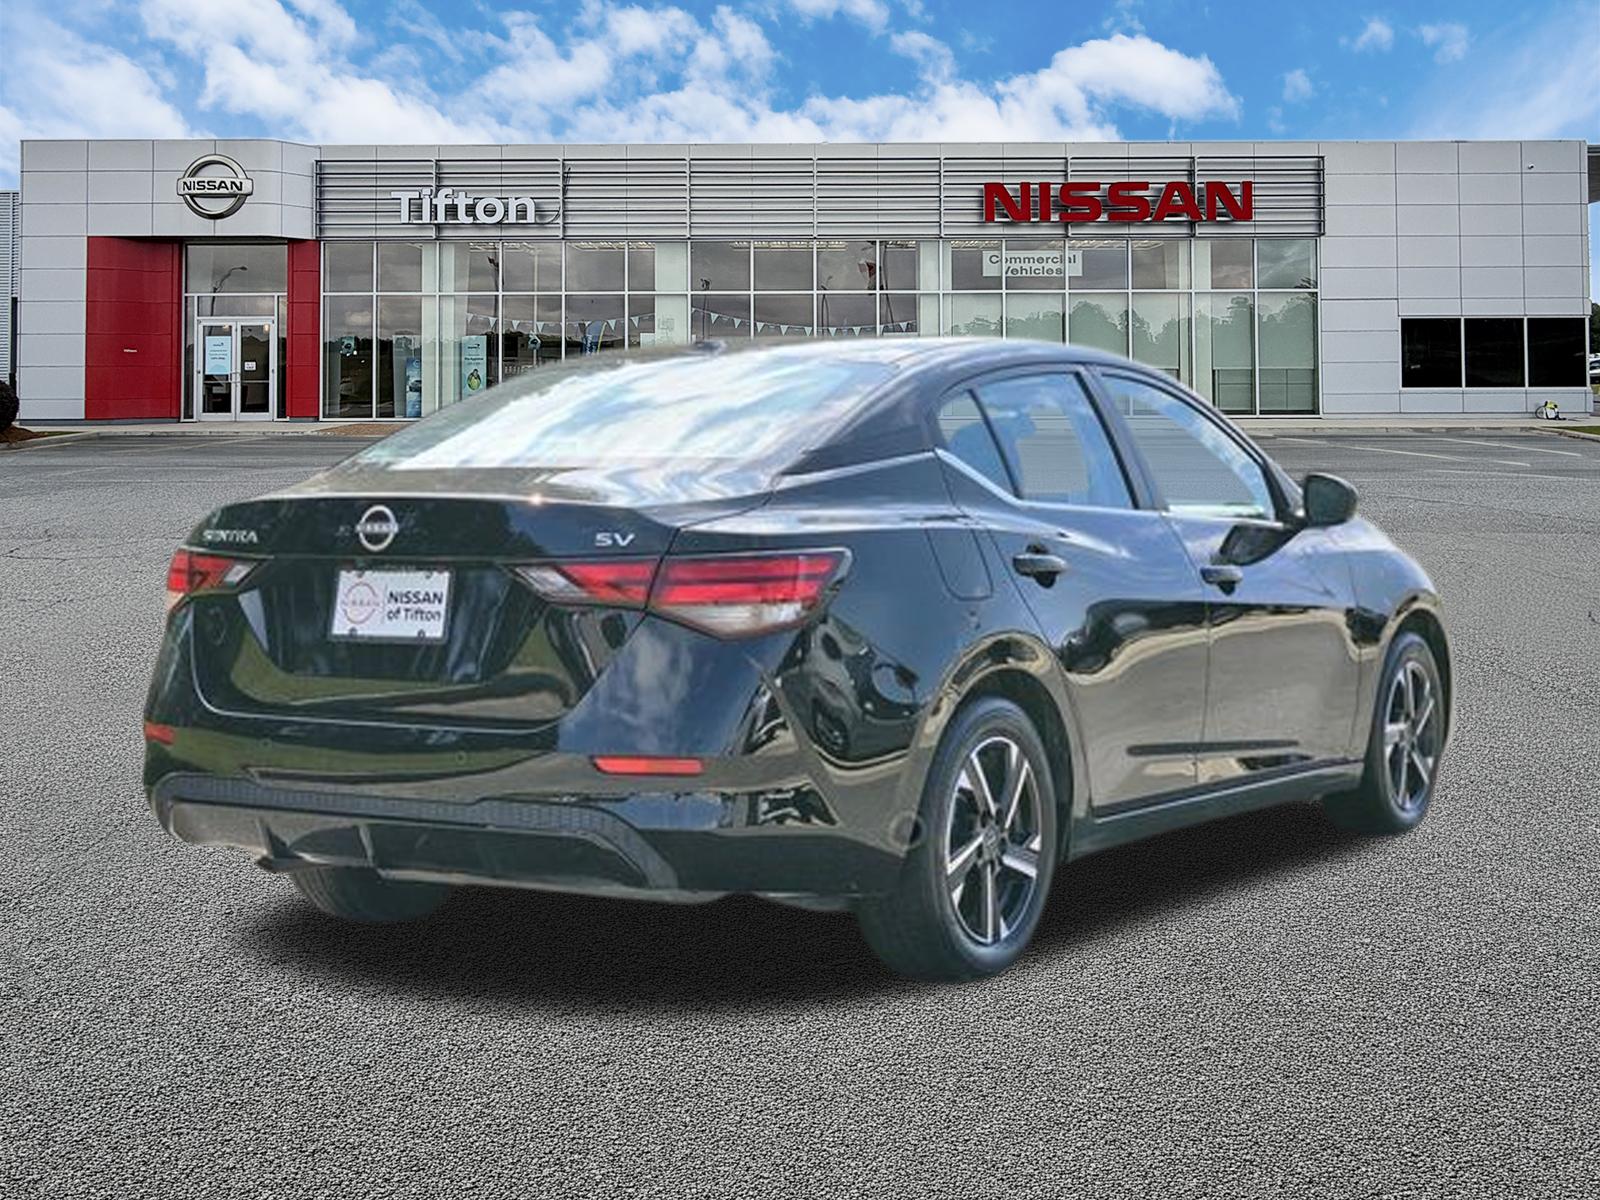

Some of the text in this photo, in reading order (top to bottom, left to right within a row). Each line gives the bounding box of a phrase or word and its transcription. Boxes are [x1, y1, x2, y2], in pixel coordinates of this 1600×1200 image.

[183, 181, 243, 191] NISSAN
[391, 188, 536, 224] Tifton
[984, 181, 1253, 222] NISSAN
[595, 532, 635, 547] SV
[387, 591, 444, 605] NISSAN
[386, 607, 441, 622] of Tifton
